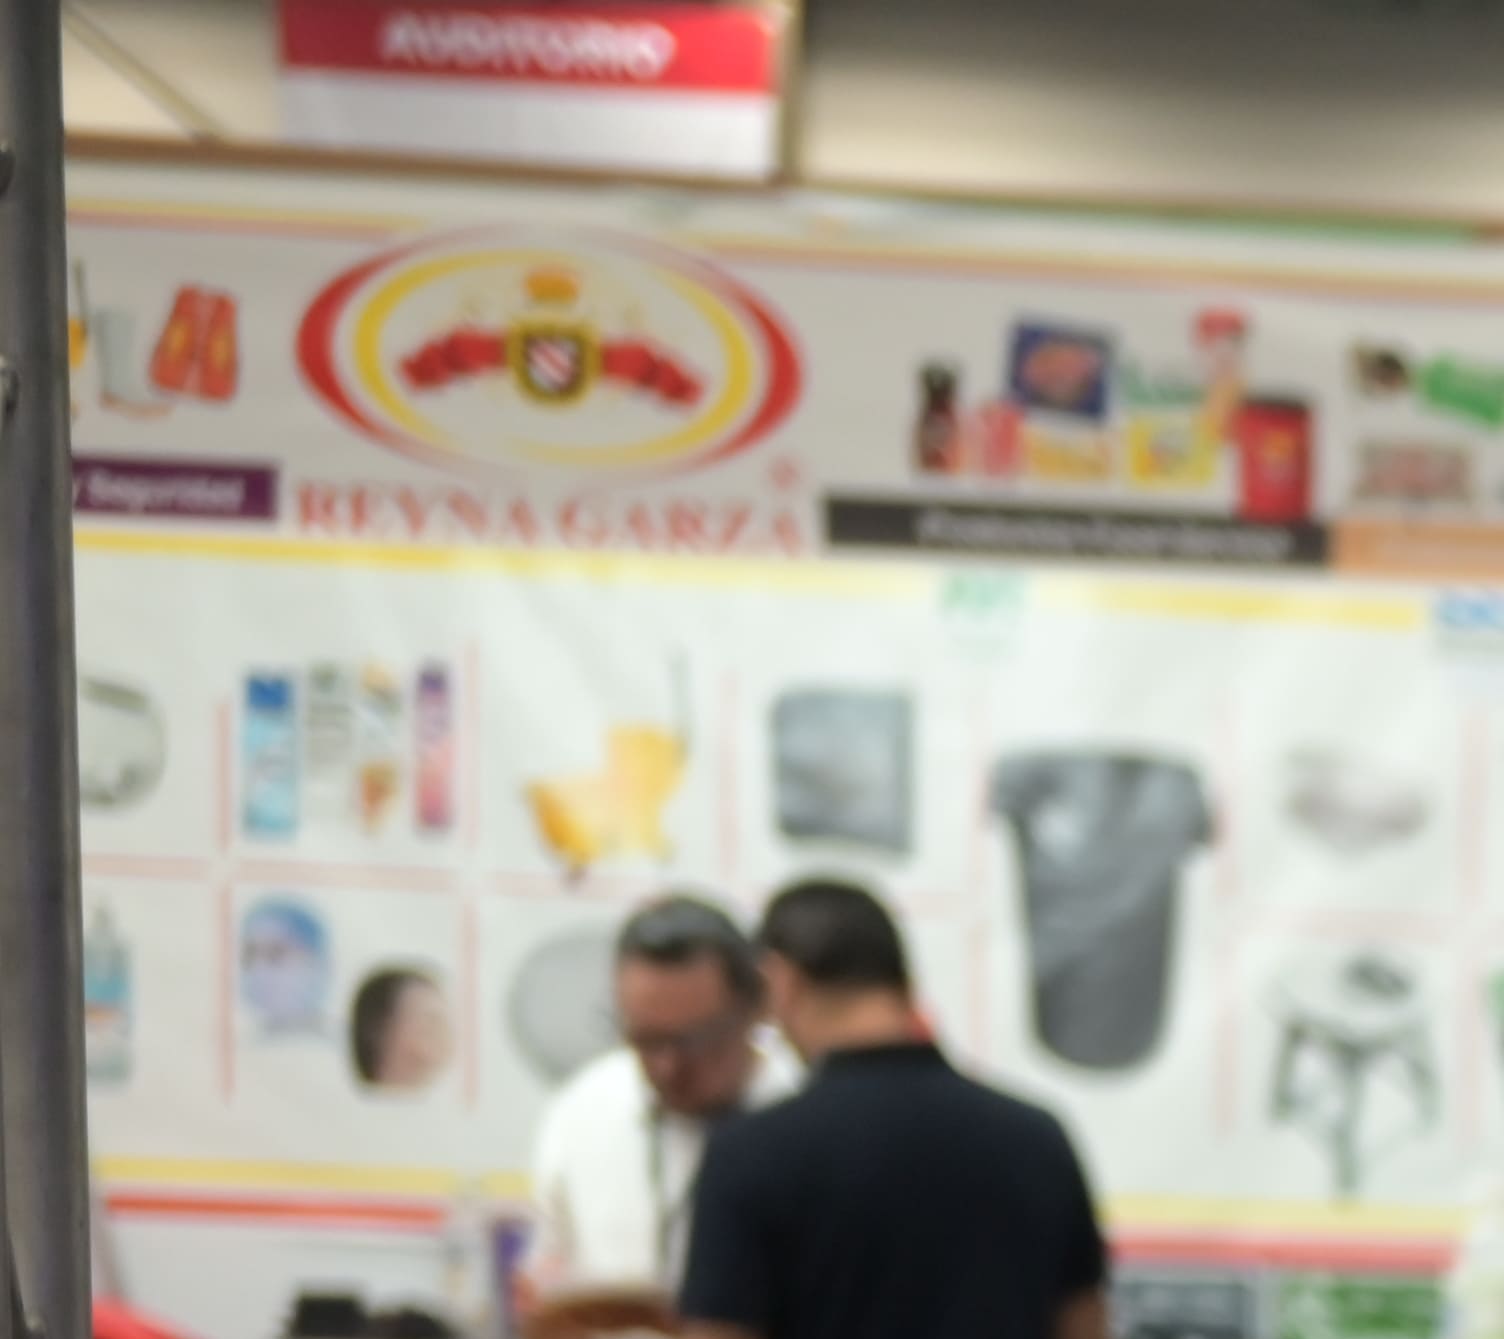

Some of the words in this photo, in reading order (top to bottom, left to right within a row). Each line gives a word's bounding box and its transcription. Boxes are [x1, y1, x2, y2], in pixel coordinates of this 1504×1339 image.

[382, 12, 677, 80] AUDITORIO
[296, 480, 545, 550] REYNA
[557, 498, 805, 562] GARZA
